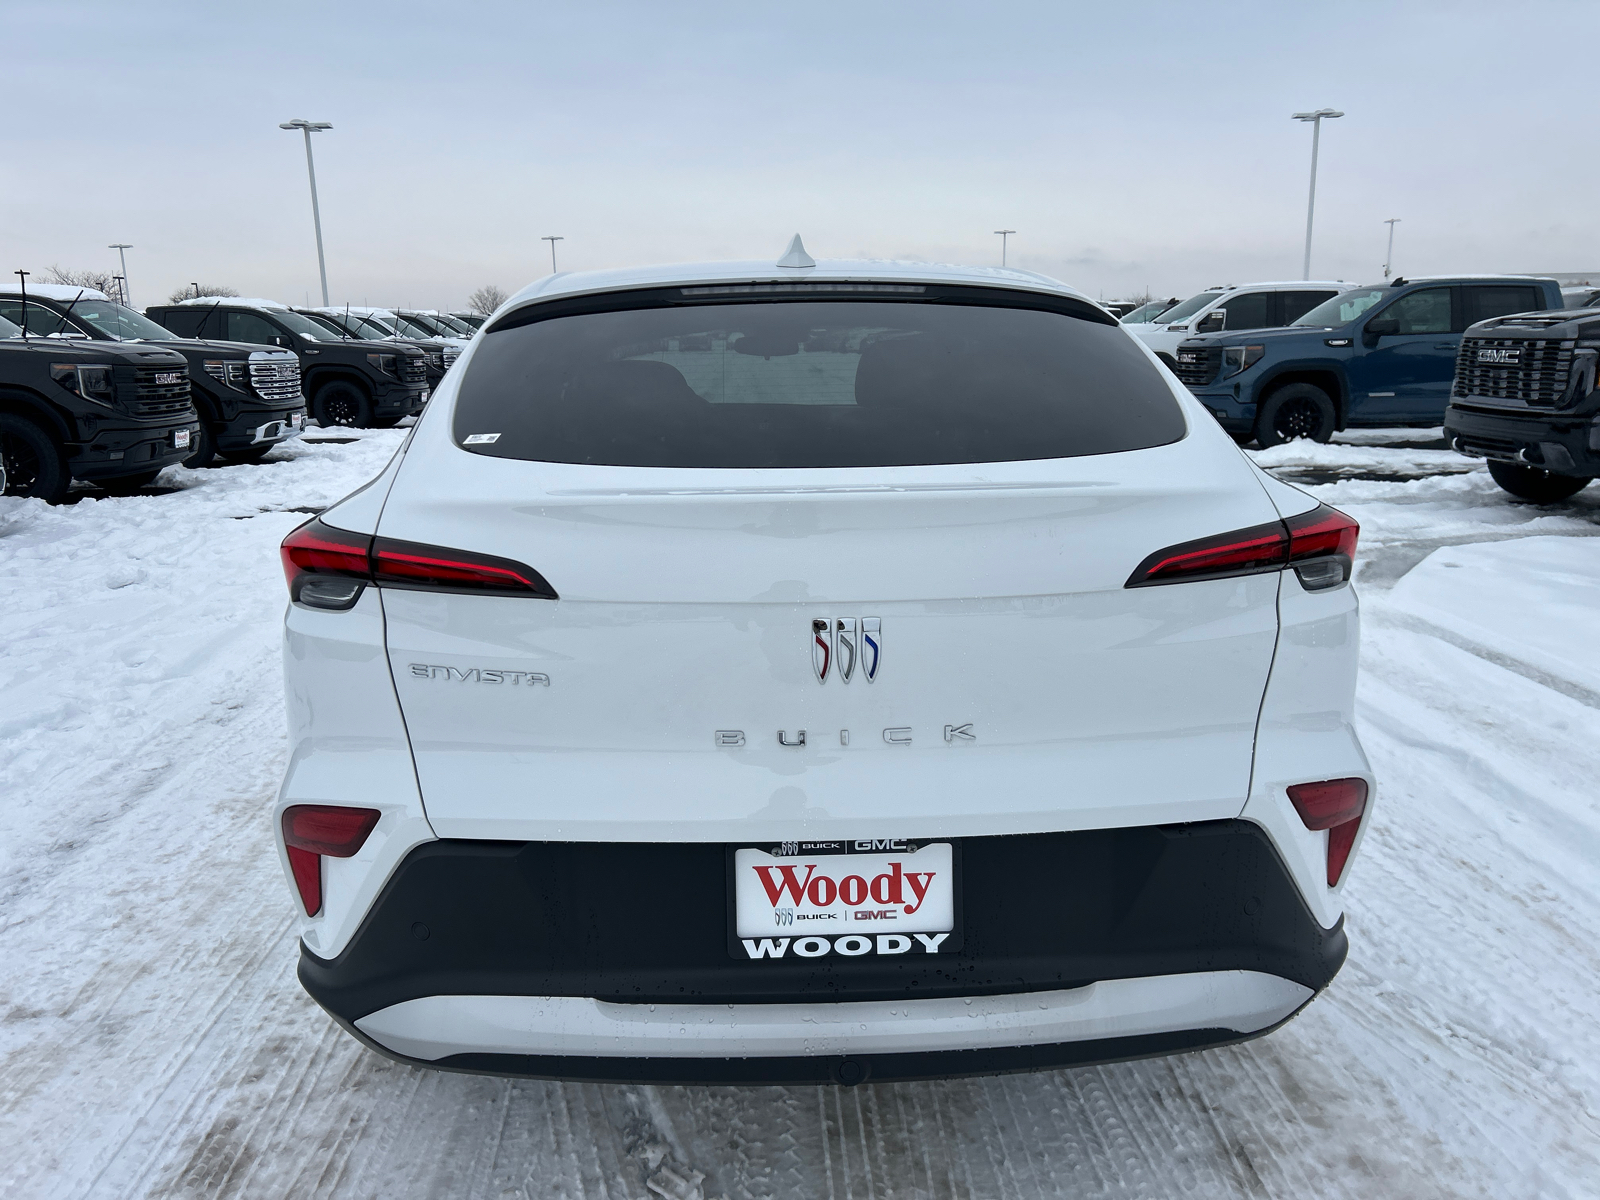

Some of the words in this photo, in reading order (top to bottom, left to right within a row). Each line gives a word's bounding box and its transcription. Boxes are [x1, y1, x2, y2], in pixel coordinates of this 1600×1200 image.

[1478, 348, 1521, 364] GMC
[155, 373, 182, 384] GMC
[408, 663, 550, 687] ENVISTA
[714, 723, 976, 747] BUICK
[802, 842, 840, 850] BUICK
[854, 839, 908, 851] GMC
[752, 862, 936, 915] Woody
[796, 912, 838, 921] BUICK
[854, 909, 898, 921] GMC
[741, 933, 950, 960] WOODY
